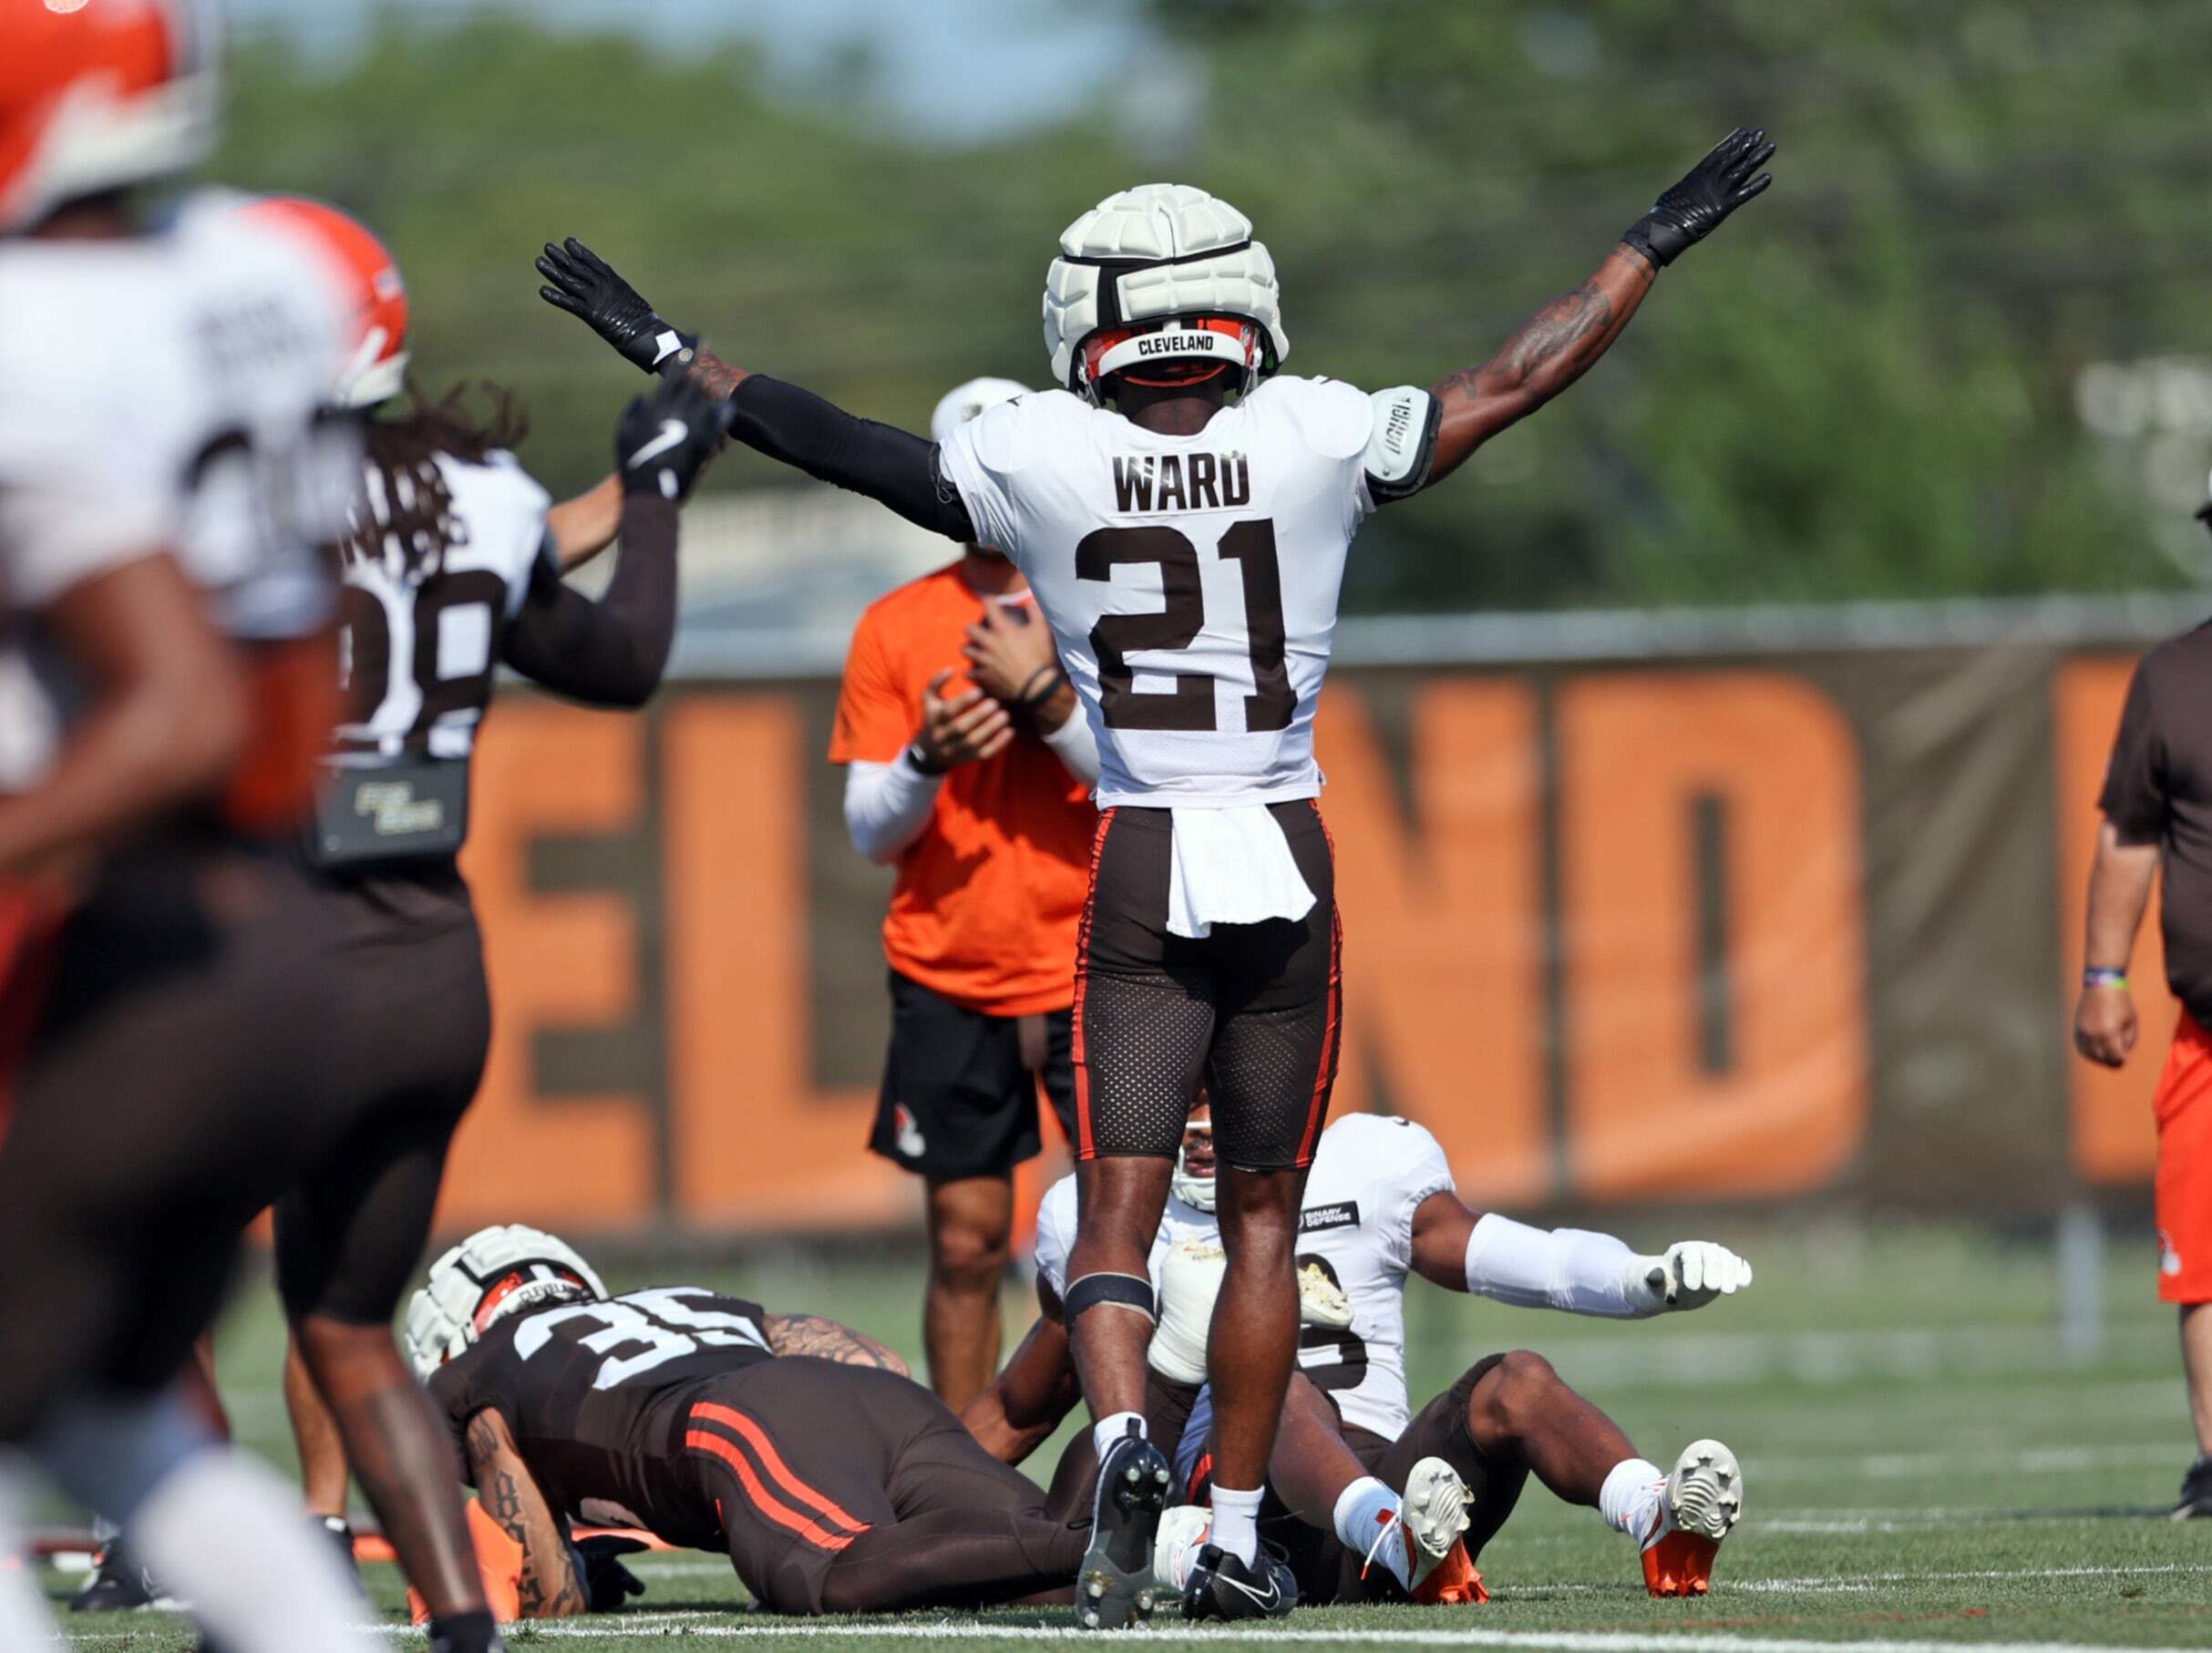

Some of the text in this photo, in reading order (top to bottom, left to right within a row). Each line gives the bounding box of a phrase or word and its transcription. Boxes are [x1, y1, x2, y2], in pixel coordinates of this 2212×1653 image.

[1138, 335, 1214, 355] CLEVELAND
[1113, 451, 1251, 512] WARD
[1075, 517, 1299, 733] 21
[1304, 1206, 1343, 1221] BINARY
[1306, 1212, 1352, 1227] DEFENSE
